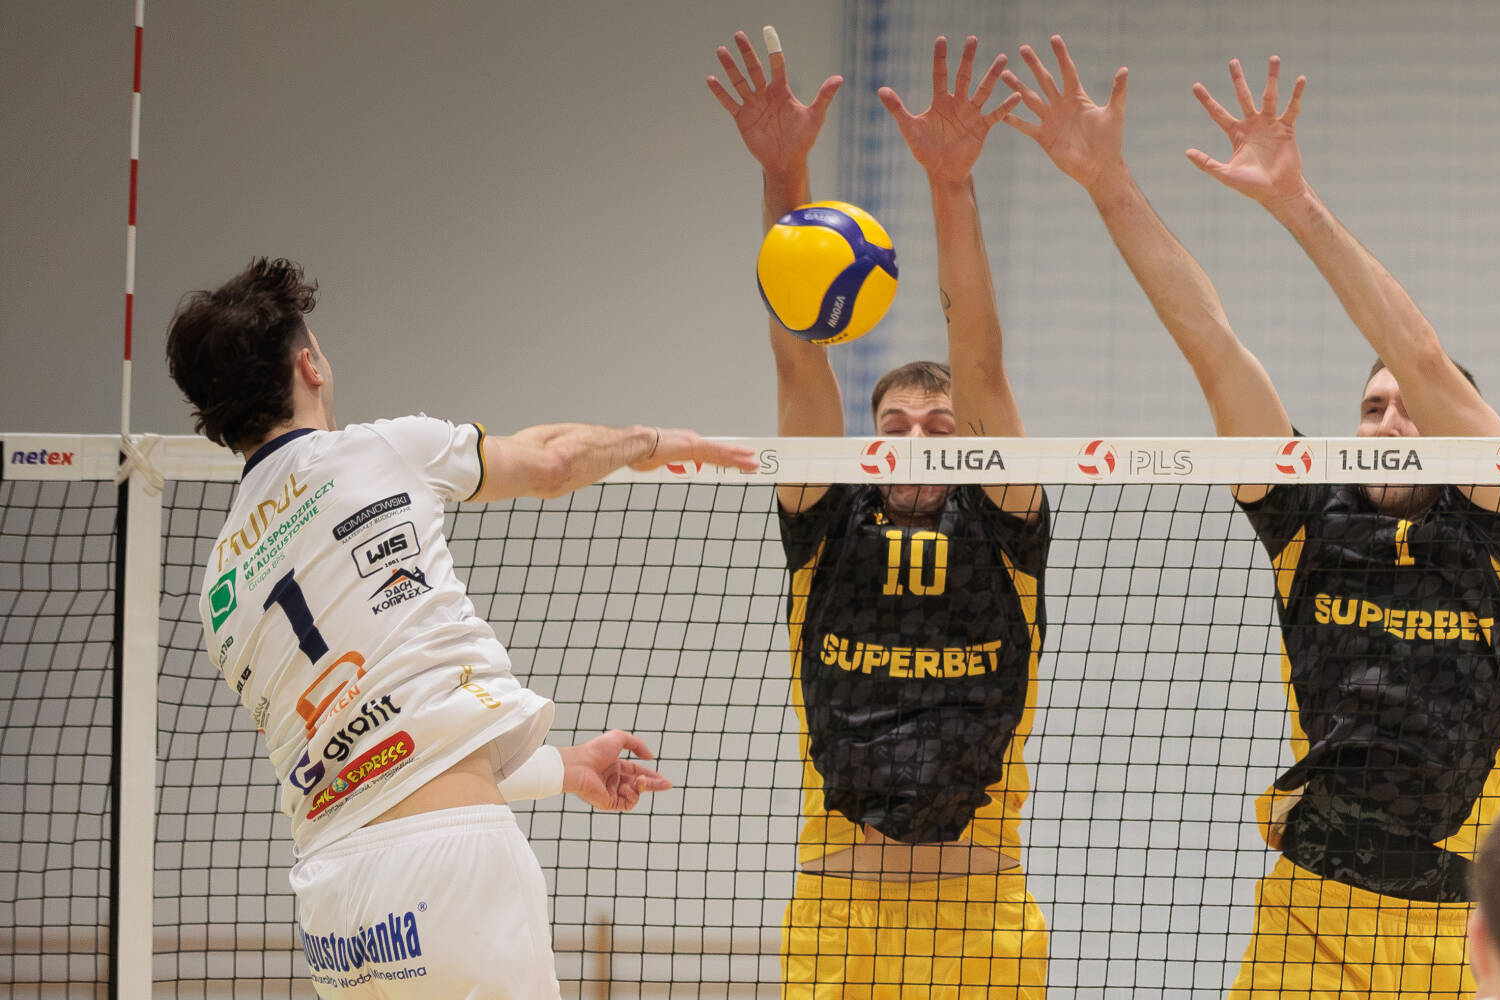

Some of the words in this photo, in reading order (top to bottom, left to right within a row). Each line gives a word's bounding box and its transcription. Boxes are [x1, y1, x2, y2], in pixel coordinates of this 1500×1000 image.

[11, 448, 75, 466] netex
[1129, 449, 1194, 476] PLS
[242, 541, 268, 571] BANK
[266, 479, 335, 547] SPÓŁDZIELCZY
[255, 505, 320, 574] AUGUSTOWIE
[336, 495, 408, 537] ROMANOWSKI
[366, 533, 408, 565] WIS
[883, 530, 948, 596] 10
[1394, 519, 1415, 566] 1
[372, 586, 421, 616] KOMPLEX
[384, 579, 413, 598] DACH
[262, 567, 330, 666] 1
[1313, 593, 1495, 647] SUPERBET
[820, 632, 1002, 679] SUPERBET
[323, 694, 402, 763] grafit
[346, 740, 408, 784] EXPRESS
